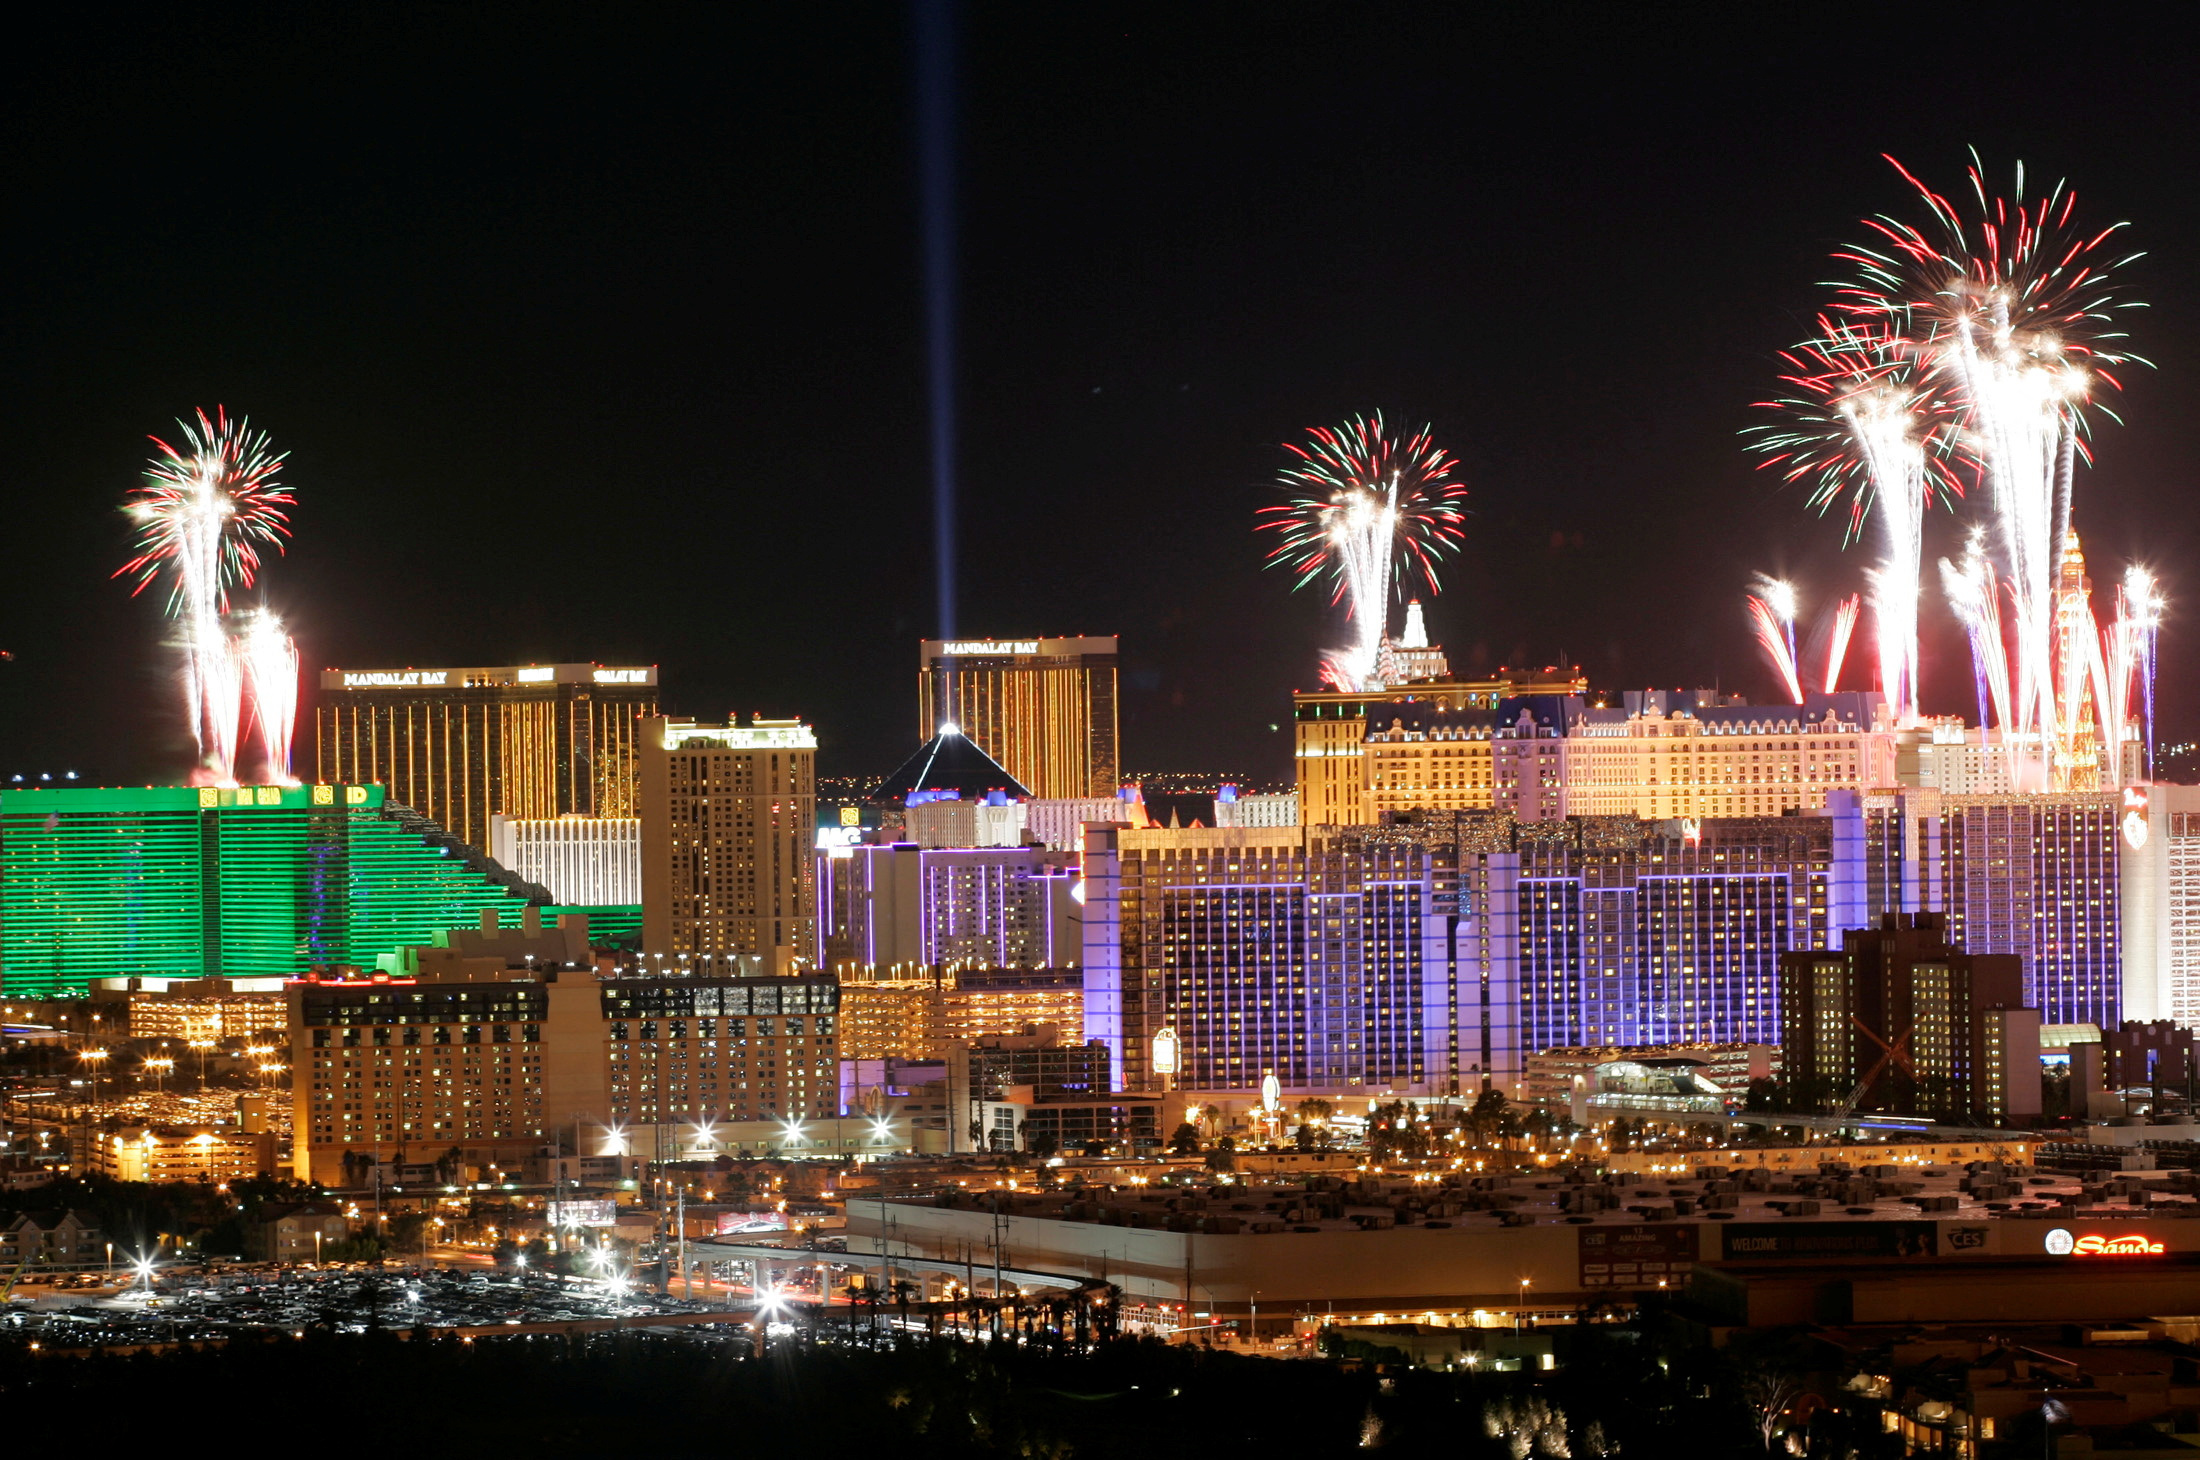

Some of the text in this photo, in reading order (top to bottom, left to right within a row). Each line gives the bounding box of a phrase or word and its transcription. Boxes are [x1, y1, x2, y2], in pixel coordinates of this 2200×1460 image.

[943, 641, 1038, 654] MANDALAY BAY
[344, 672, 448, 686] MANDALAY BAY
[1618, 1234, 1657, 1242] AMAZING
[1731, 1237, 1778, 1251] WELCOME
[1952, 1233, 1980, 1246] CES
[2073, 1235, 2165, 1255] Sands
